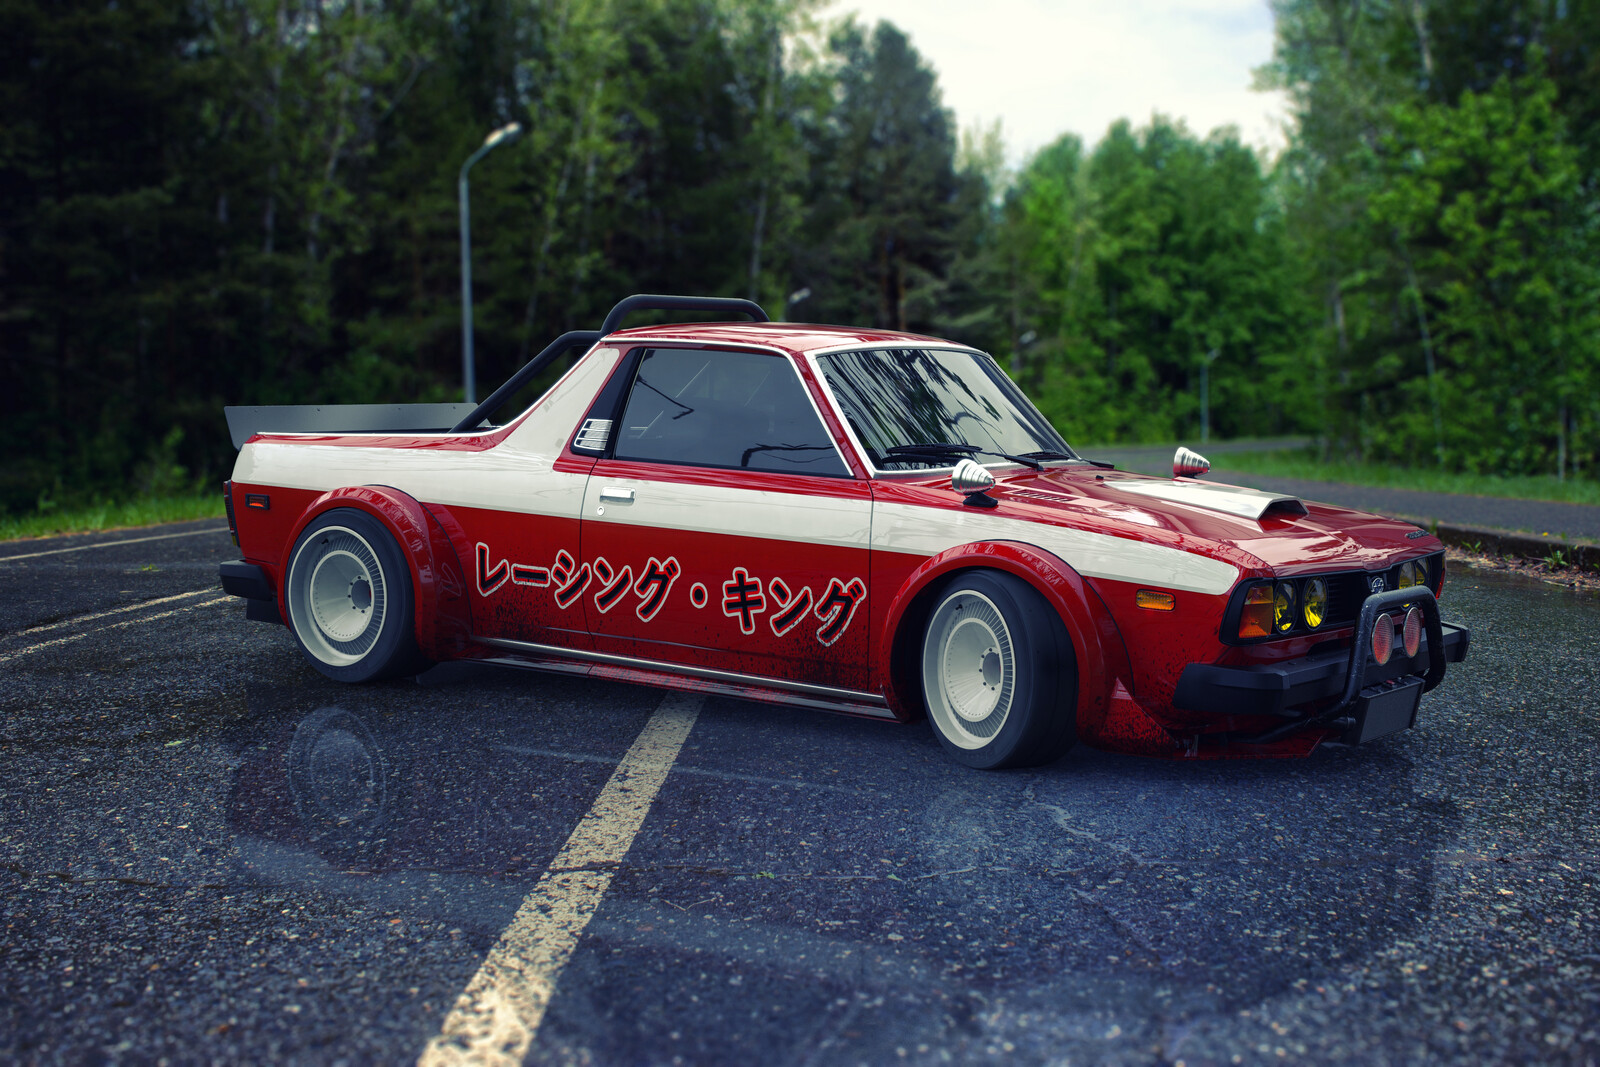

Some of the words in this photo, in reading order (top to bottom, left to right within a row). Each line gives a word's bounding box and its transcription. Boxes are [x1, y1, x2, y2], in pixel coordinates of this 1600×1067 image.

[475, 542, 867, 646] レーシング・キング
